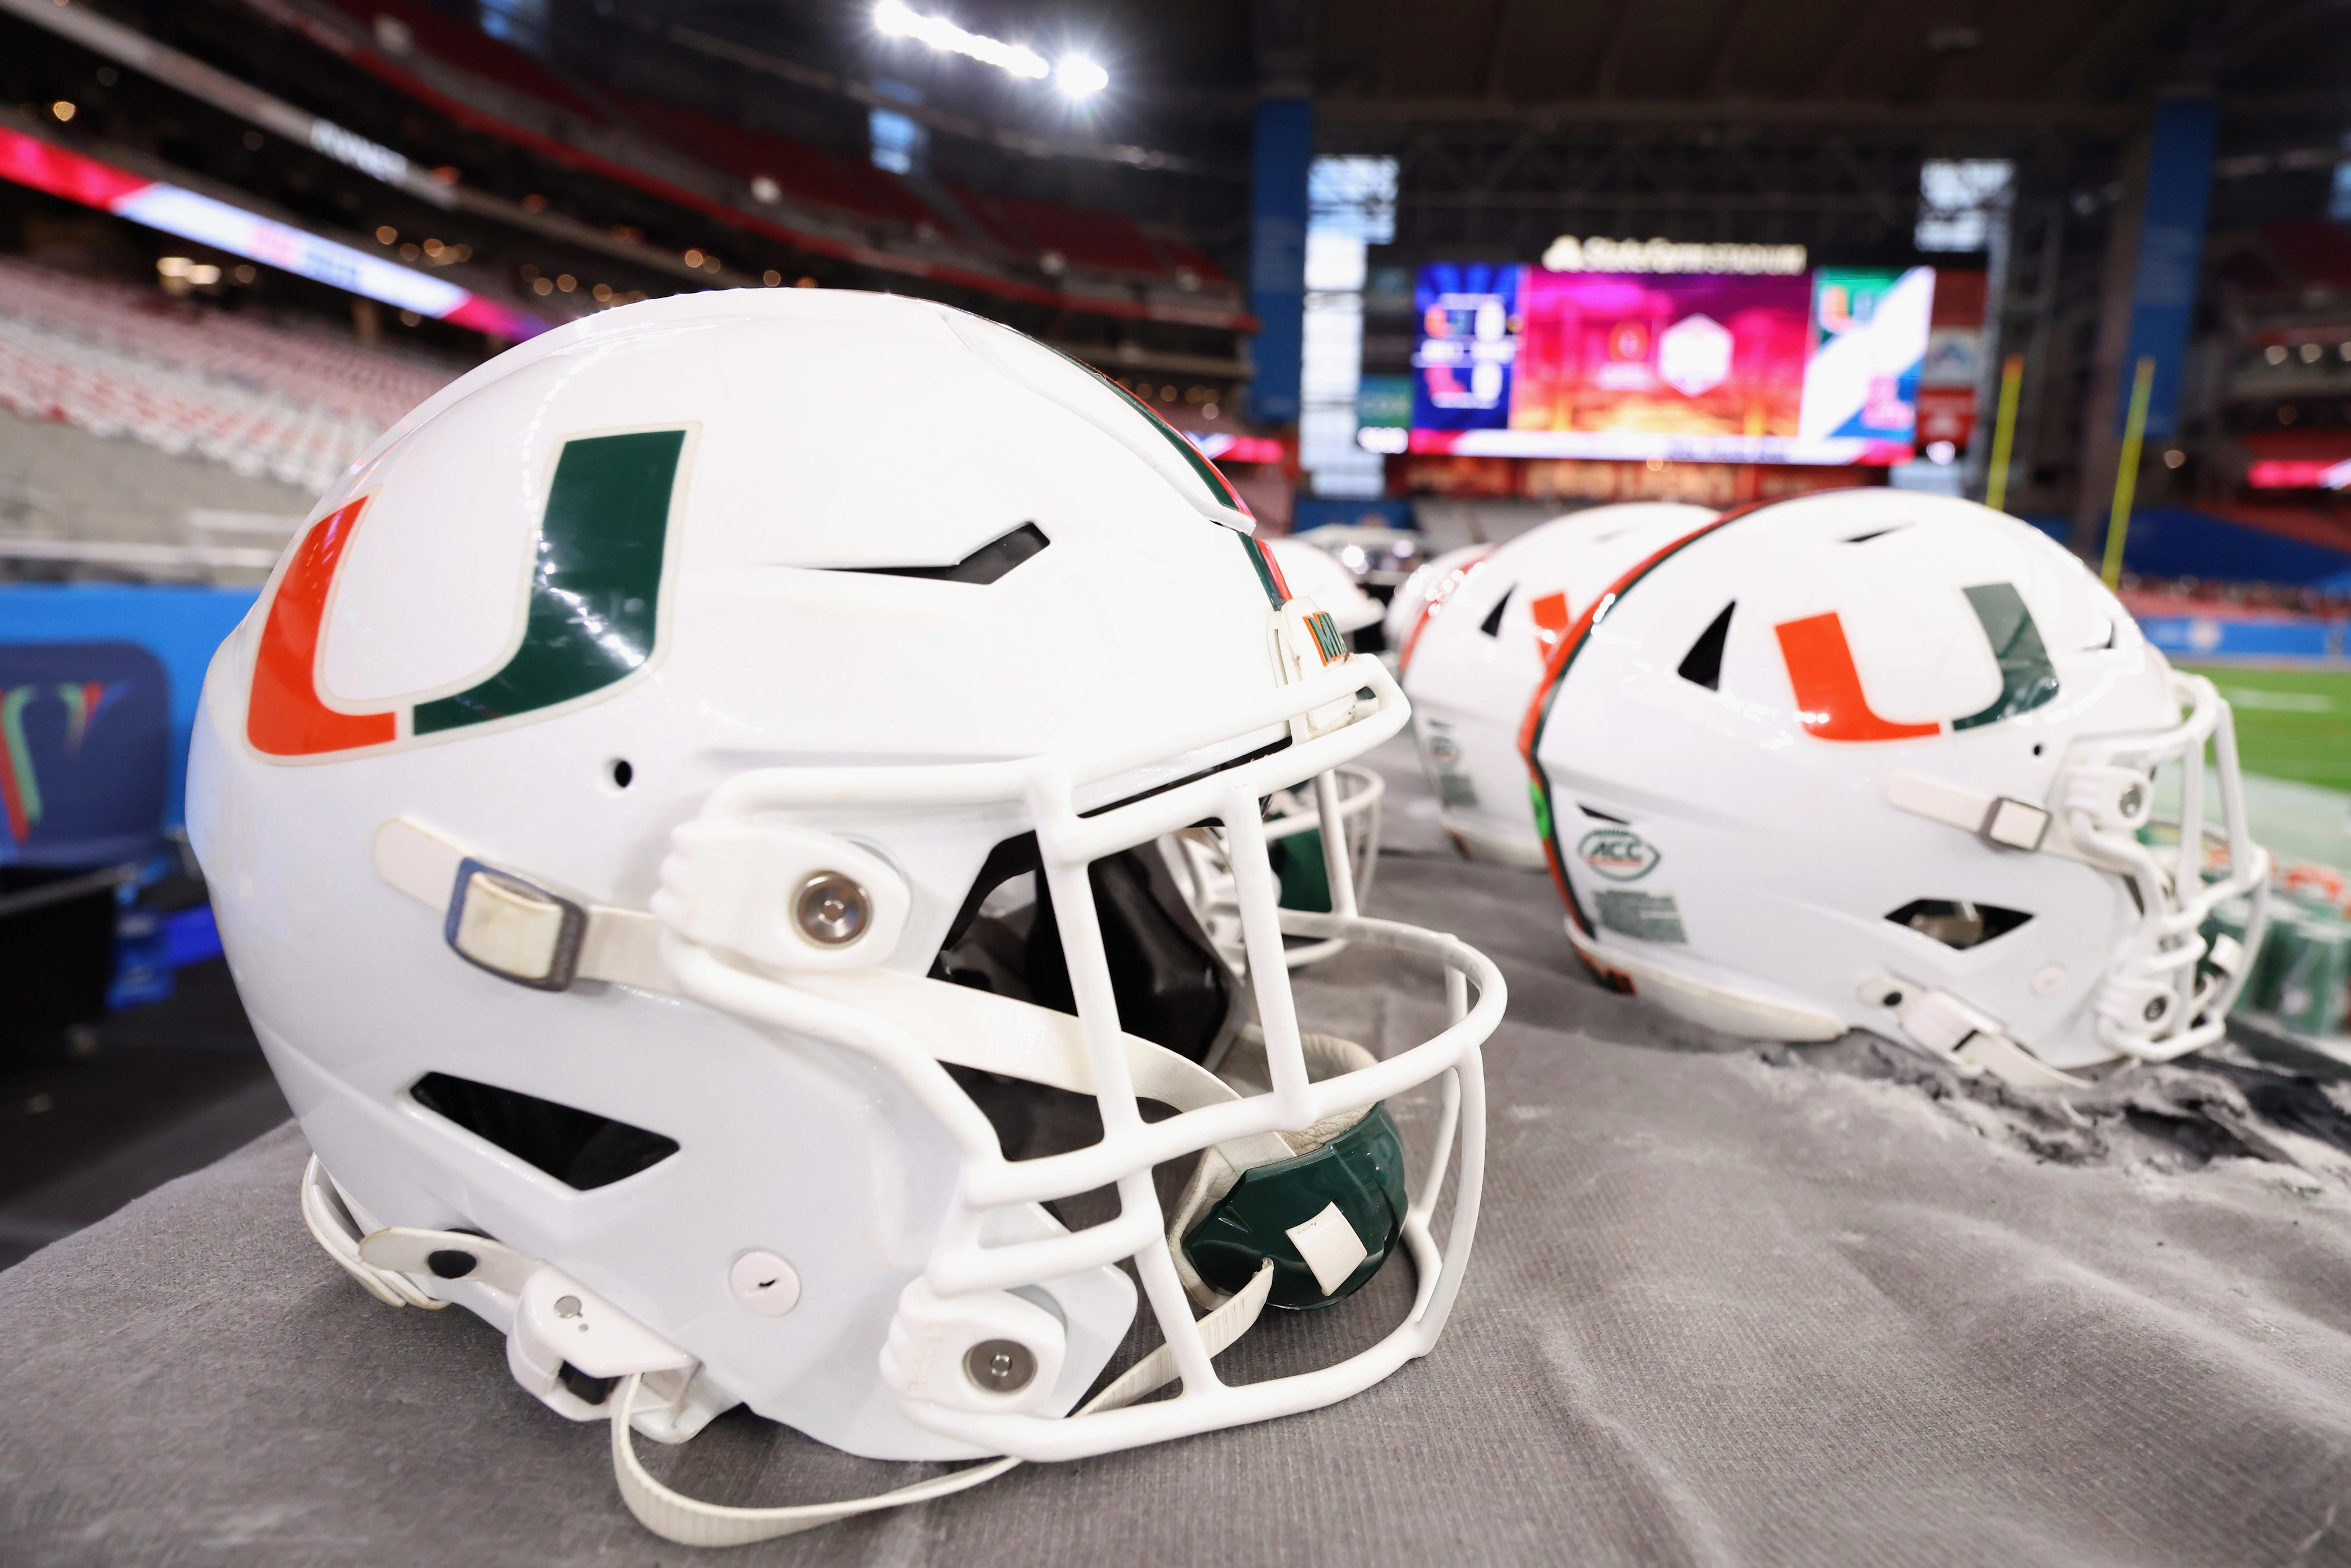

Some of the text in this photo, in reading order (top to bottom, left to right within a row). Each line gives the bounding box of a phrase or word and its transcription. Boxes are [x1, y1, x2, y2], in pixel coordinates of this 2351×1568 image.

[245, 428, 689, 757] U
[1774, 582, 2060, 742] U
[1591, 841, 1642, 861] ACC
